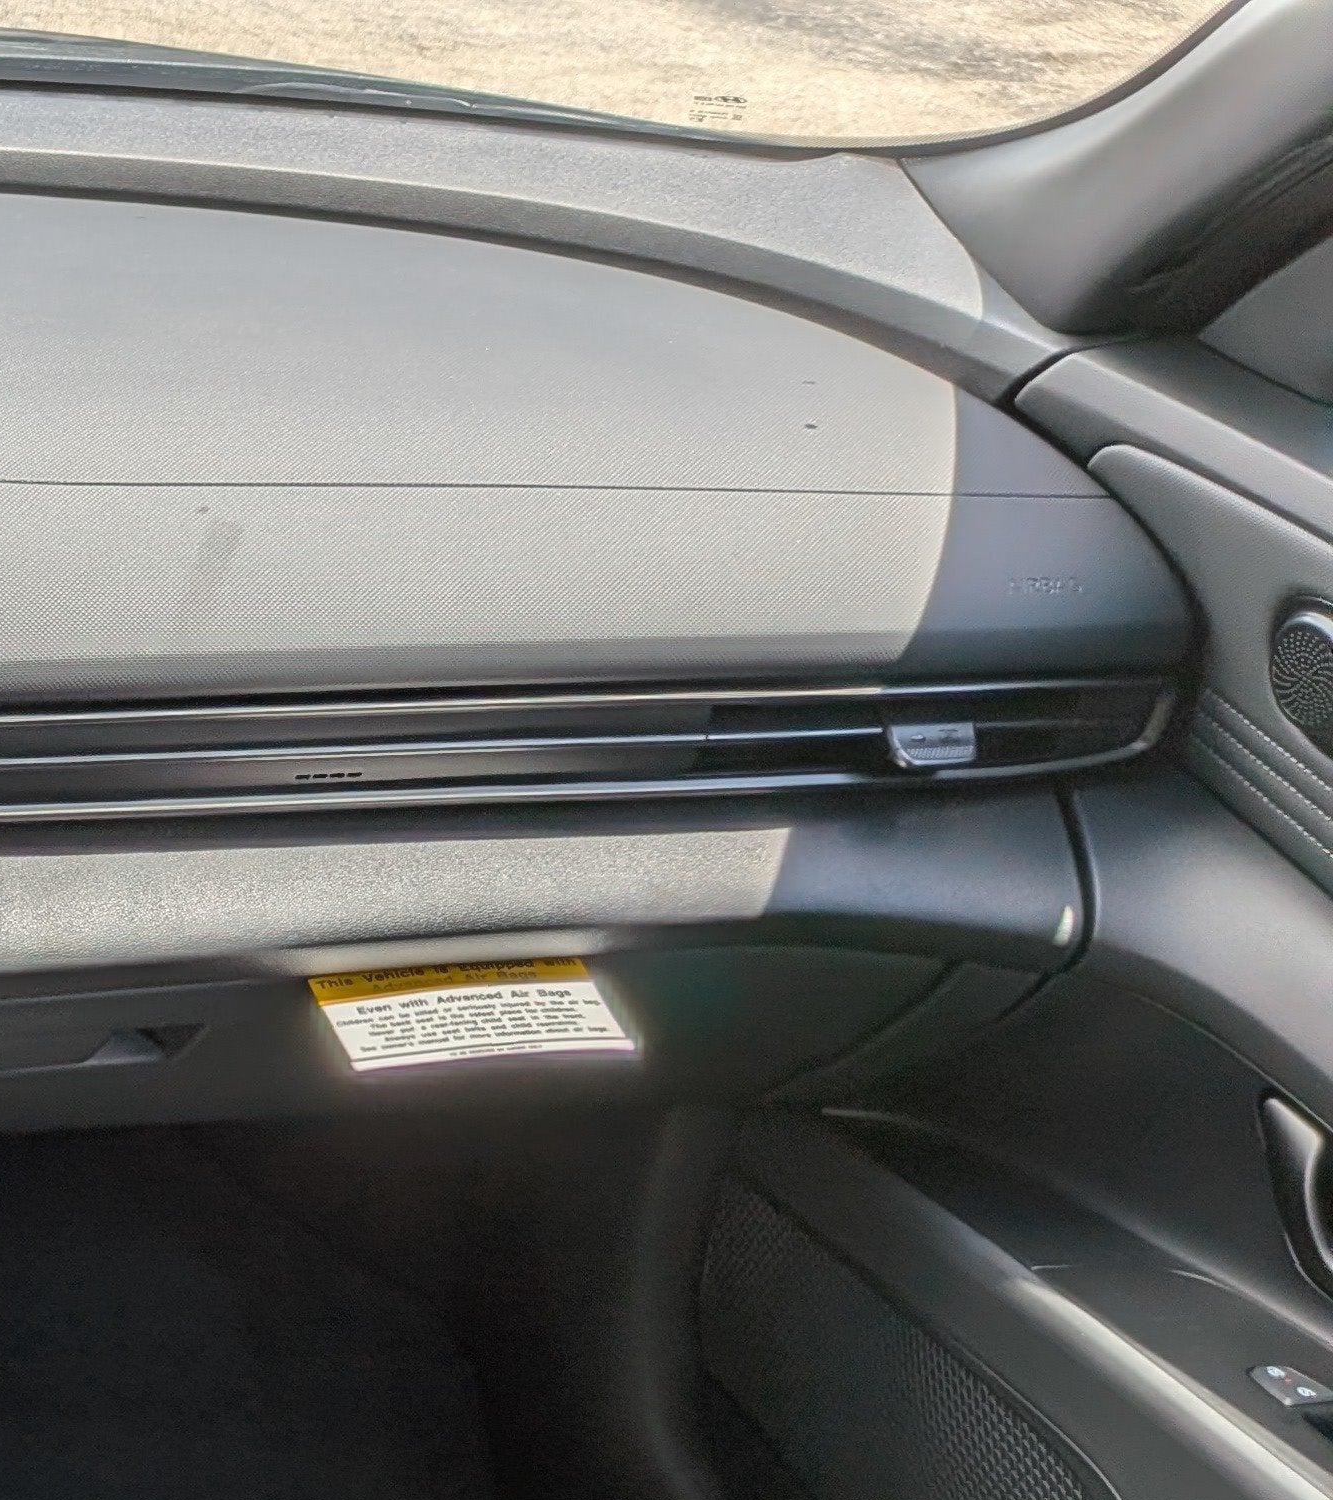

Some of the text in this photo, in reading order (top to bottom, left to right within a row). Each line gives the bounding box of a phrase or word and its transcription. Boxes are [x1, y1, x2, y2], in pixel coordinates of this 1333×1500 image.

[315, 978, 353, 989] This
[361, 967, 424, 983] Vehicle
[356, 988, 572, 1014] Even with Advanced Air Bags
